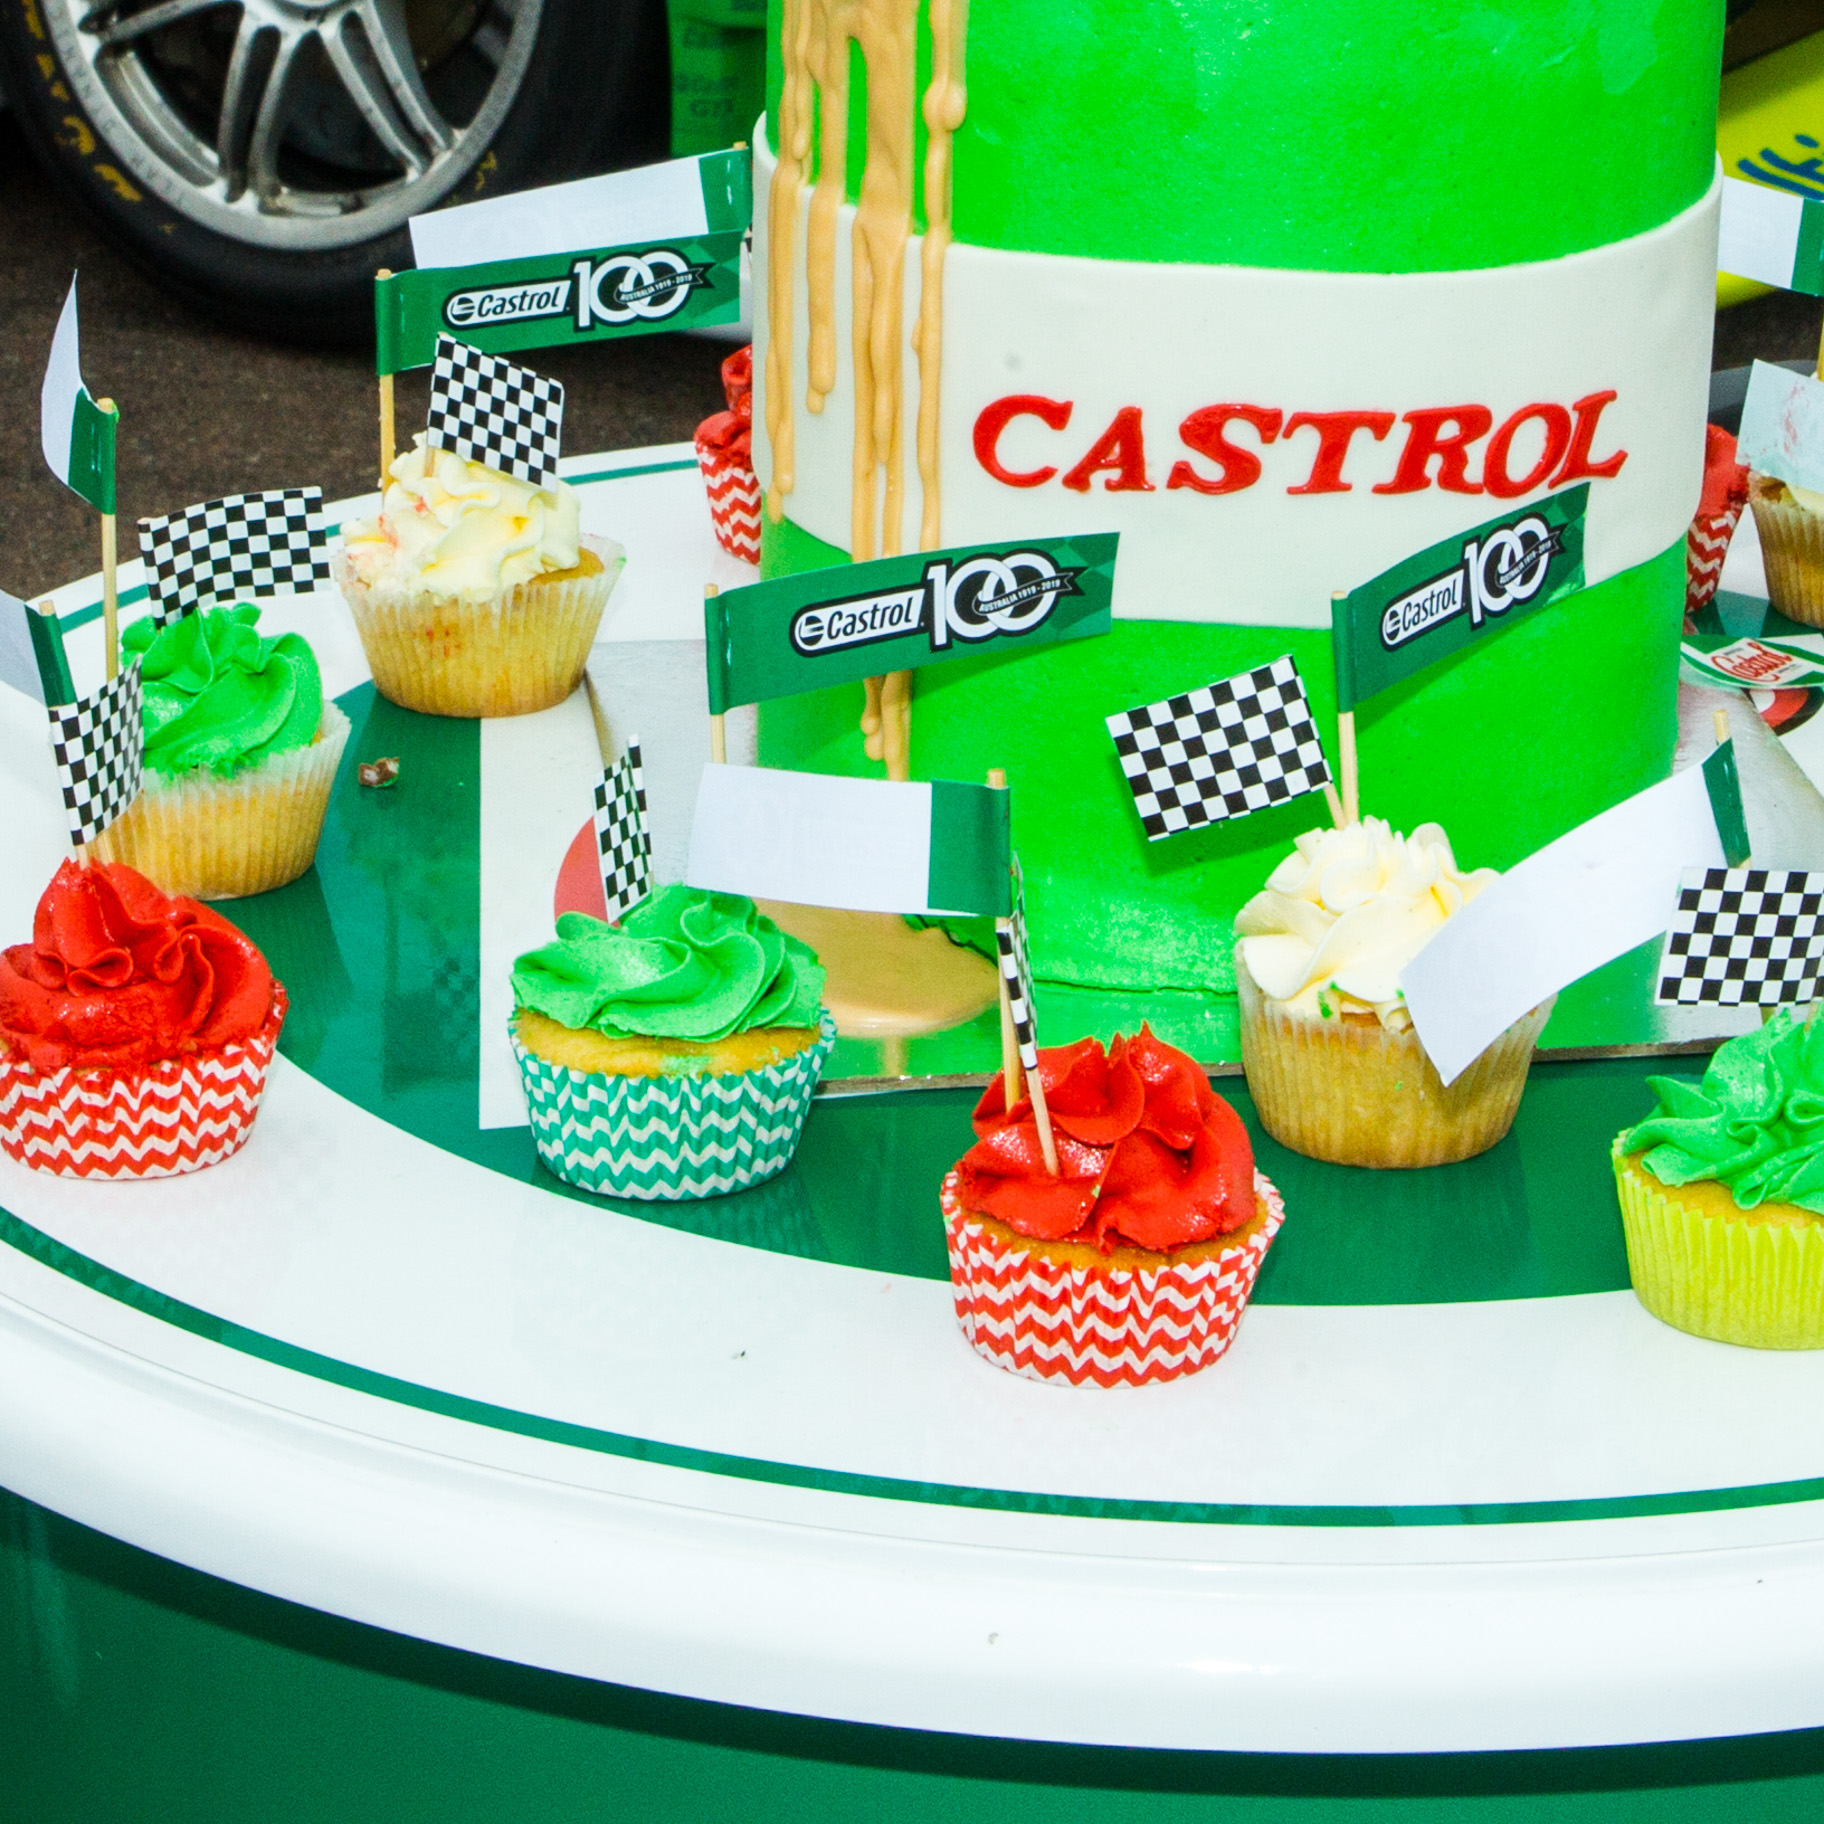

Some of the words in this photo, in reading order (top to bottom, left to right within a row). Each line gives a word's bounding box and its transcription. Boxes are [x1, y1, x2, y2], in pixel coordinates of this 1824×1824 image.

[478, 285, 561, 318] Castrol
[573, 249, 691, 329] 100
[972, 389, 1629, 499] CASTROL
[827, 596, 914, 641] Castrol
[926, 552, 1057, 646] 100
[978, 593, 1018, 613] AUSTRALIA
[1402, 578, 1458, 632] Castrol
[1463, 517, 1550, 625] 100
